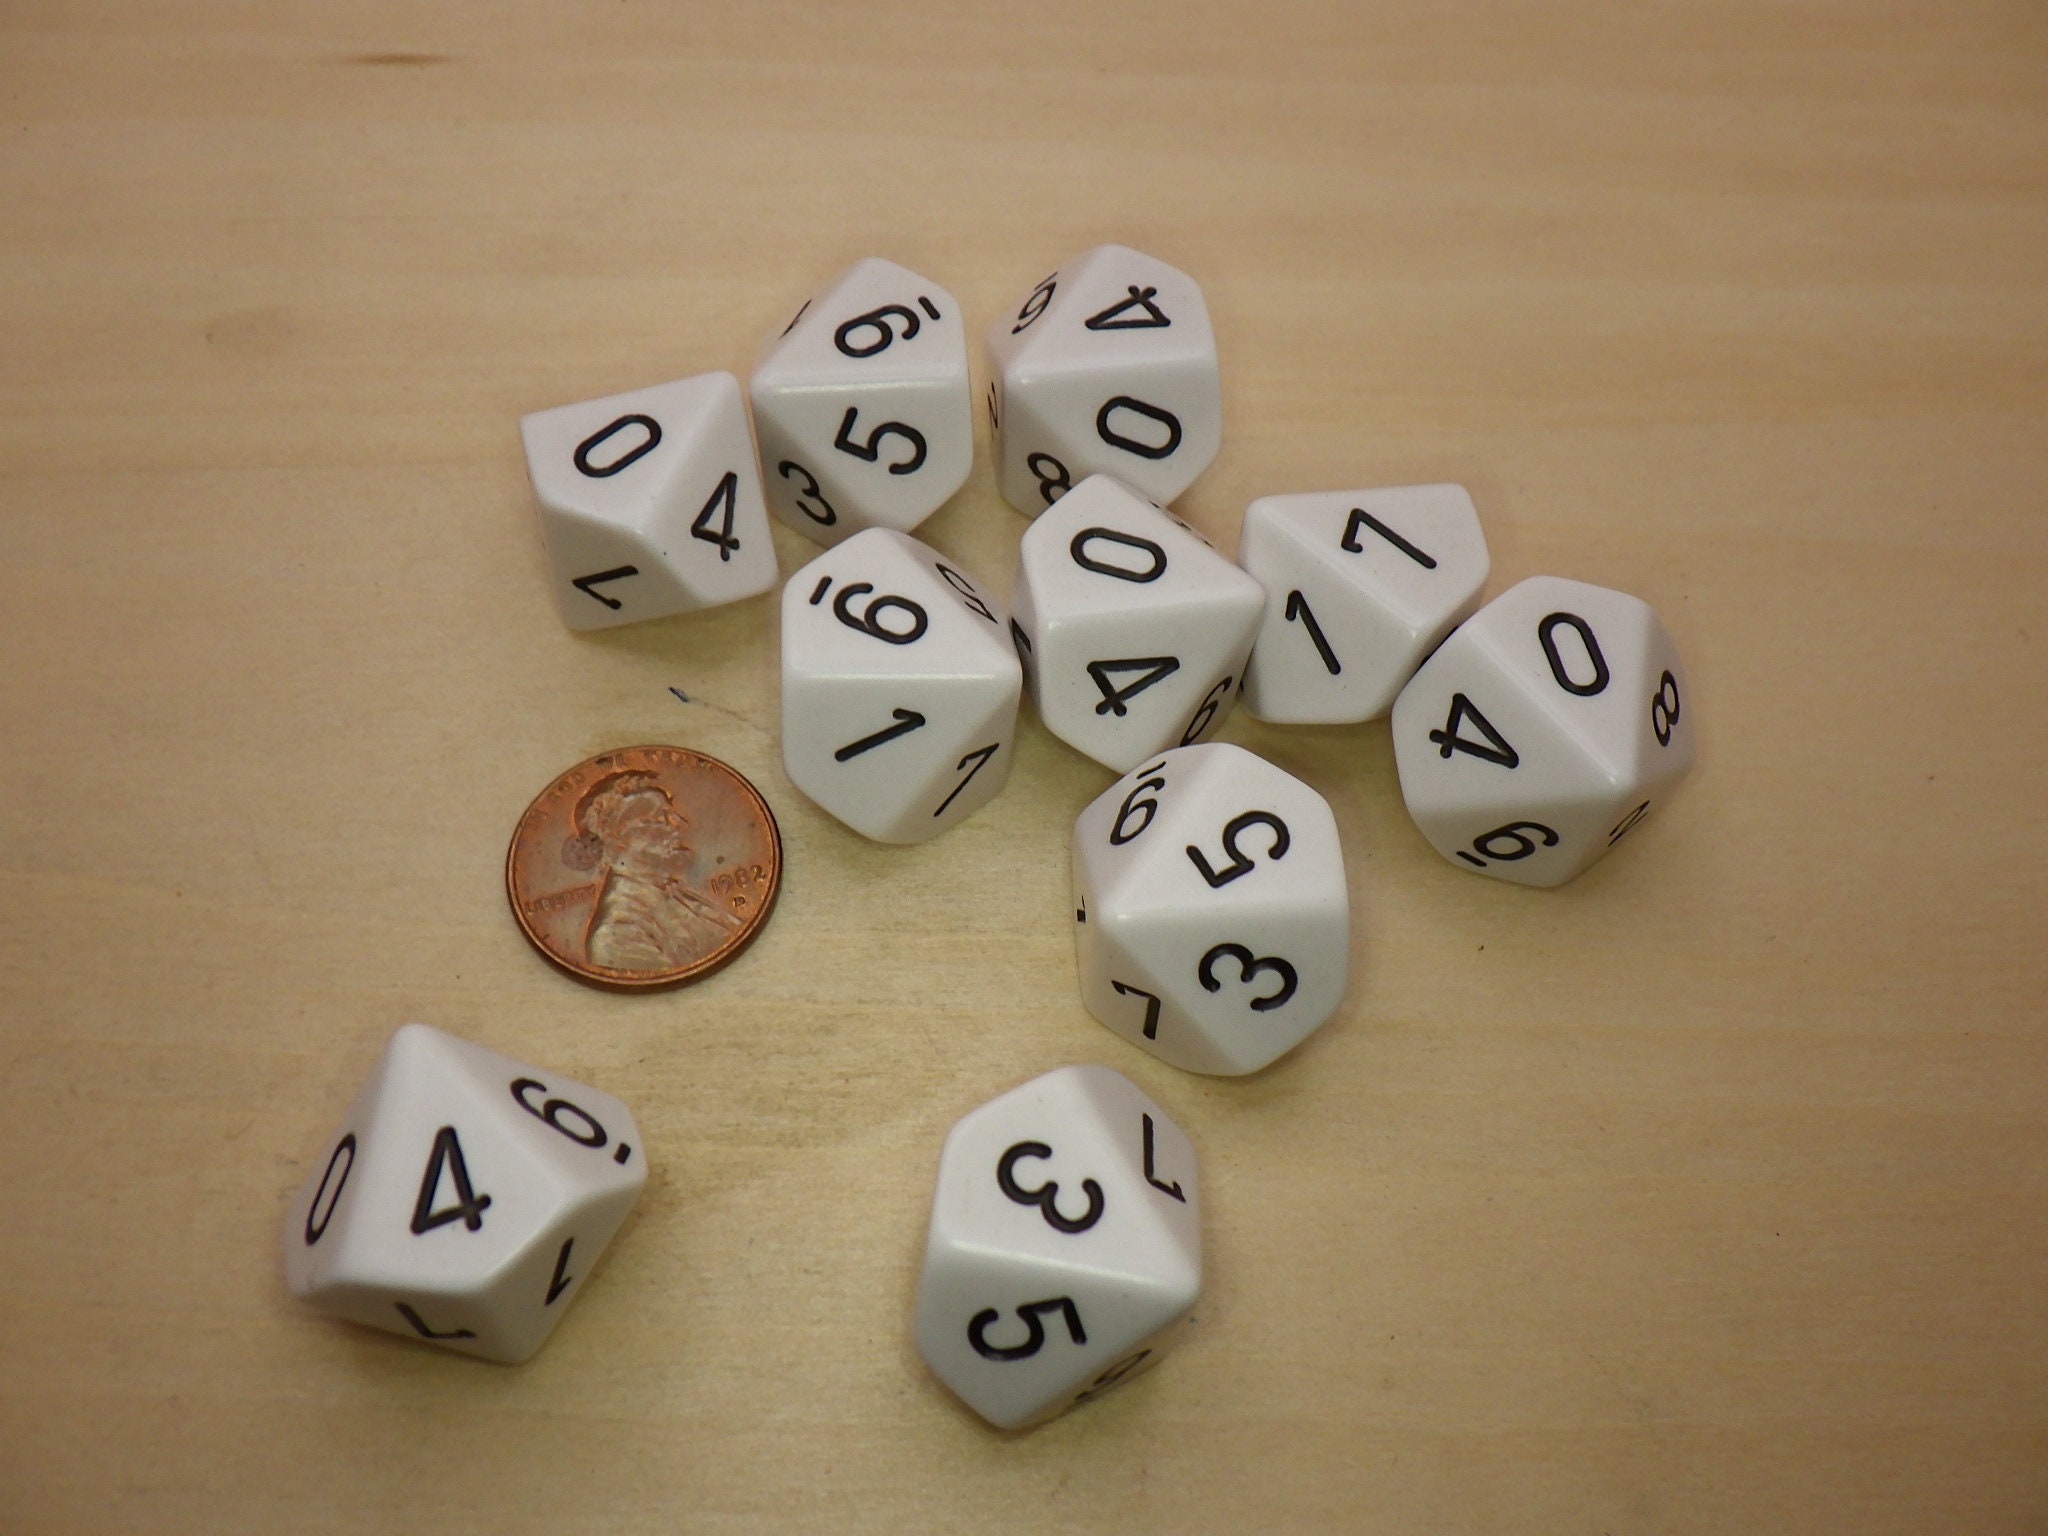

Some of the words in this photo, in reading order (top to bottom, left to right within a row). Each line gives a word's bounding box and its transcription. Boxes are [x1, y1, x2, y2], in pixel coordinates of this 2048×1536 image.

[1085, 285, 1171, 331] 4
[573, 414, 662, 478] 0
[835, 407, 927, 475] 5
[1096, 396, 1182, 459] 0
[778, 460, 837, 526] 3
[1027, 452, 1073, 506] 8
[691, 471, 740, 561] 4
[1341, 508, 1437, 569] 7
[1070, 527, 1167, 583] 0
[1285, 590, 1341, 675] 1
[1538, 612, 1610, 697] 0
[1087, 656, 1180, 717] 4
[1652, 669, 1680, 747] 8
[835, 708, 926, 762] 1
[1429, 692, 1520, 769] 4
[1186, 810, 1291, 888] 5
[1111, 980, 1161, 1040] 7
[1198, 943, 1298, 1012] 3
[305, 1133, 356, 1246] 0
[410, 1126, 492, 1235] 4
[997, 1141, 1105, 1234] 3
[967, 1297, 1087, 1362] 5
